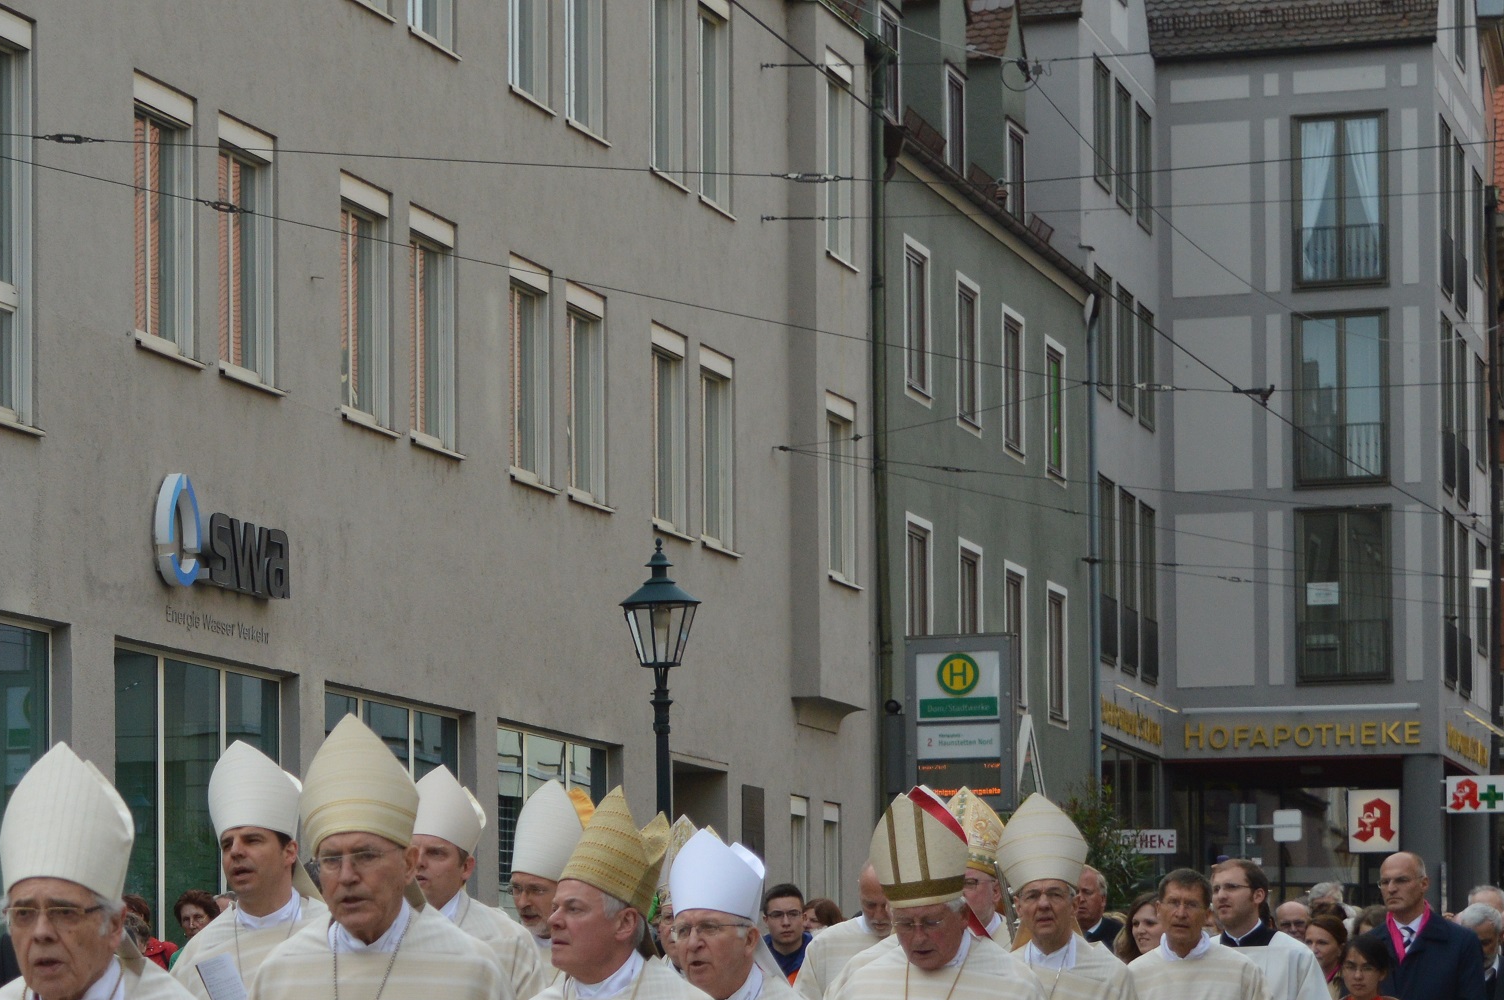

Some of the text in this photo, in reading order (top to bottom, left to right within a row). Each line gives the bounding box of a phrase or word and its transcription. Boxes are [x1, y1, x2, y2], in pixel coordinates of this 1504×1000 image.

[209, 512, 290, 599] swa
[165, 605, 269, 645] Energie Wasser Verkehr
[949, 662, 967, 687] H
[927, 737, 933, 748] 2
[938, 737, 993, 747] Haunstetten Nord
[1184, 721, 1422, 749] HOFAPOTHEKE
[1121, 833, 1176, 849] OTHEKE
